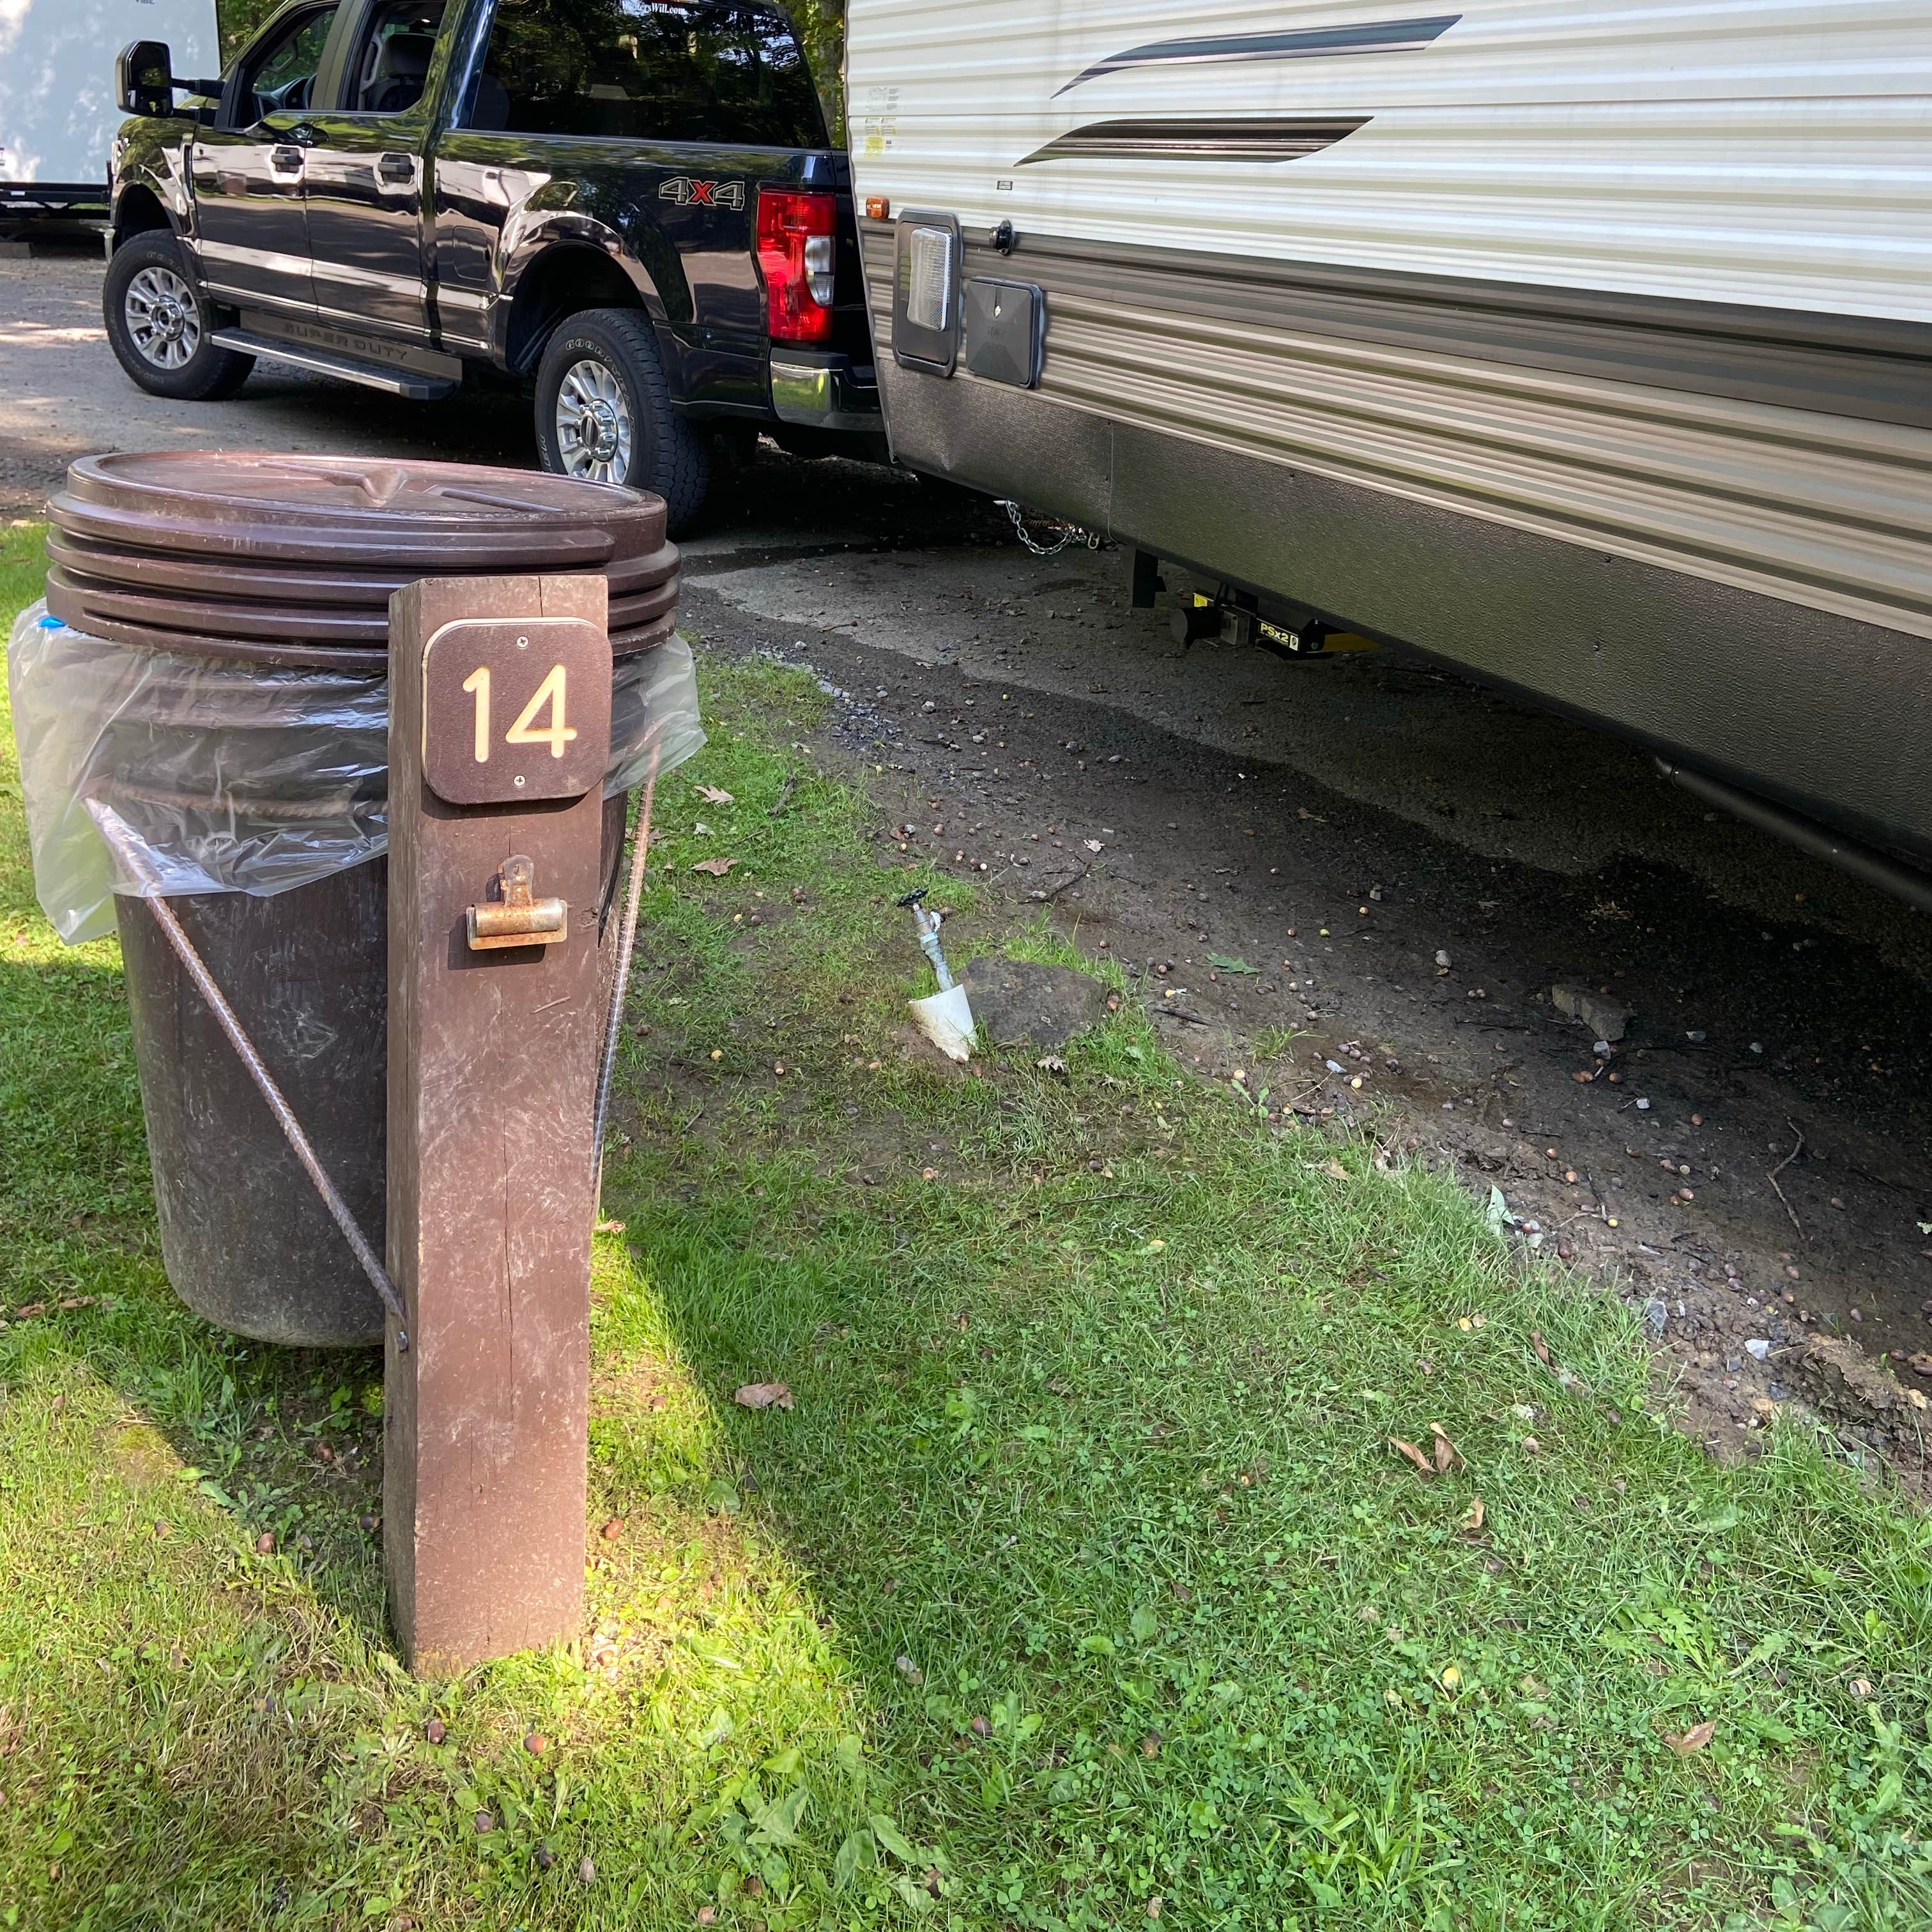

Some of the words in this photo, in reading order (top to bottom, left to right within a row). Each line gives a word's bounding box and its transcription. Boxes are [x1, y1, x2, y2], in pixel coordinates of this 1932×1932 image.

[284, 323, 348, 346] SUPER
[353, 339, 408, 360] DUTY
[463, 663, 578, 763] 14
